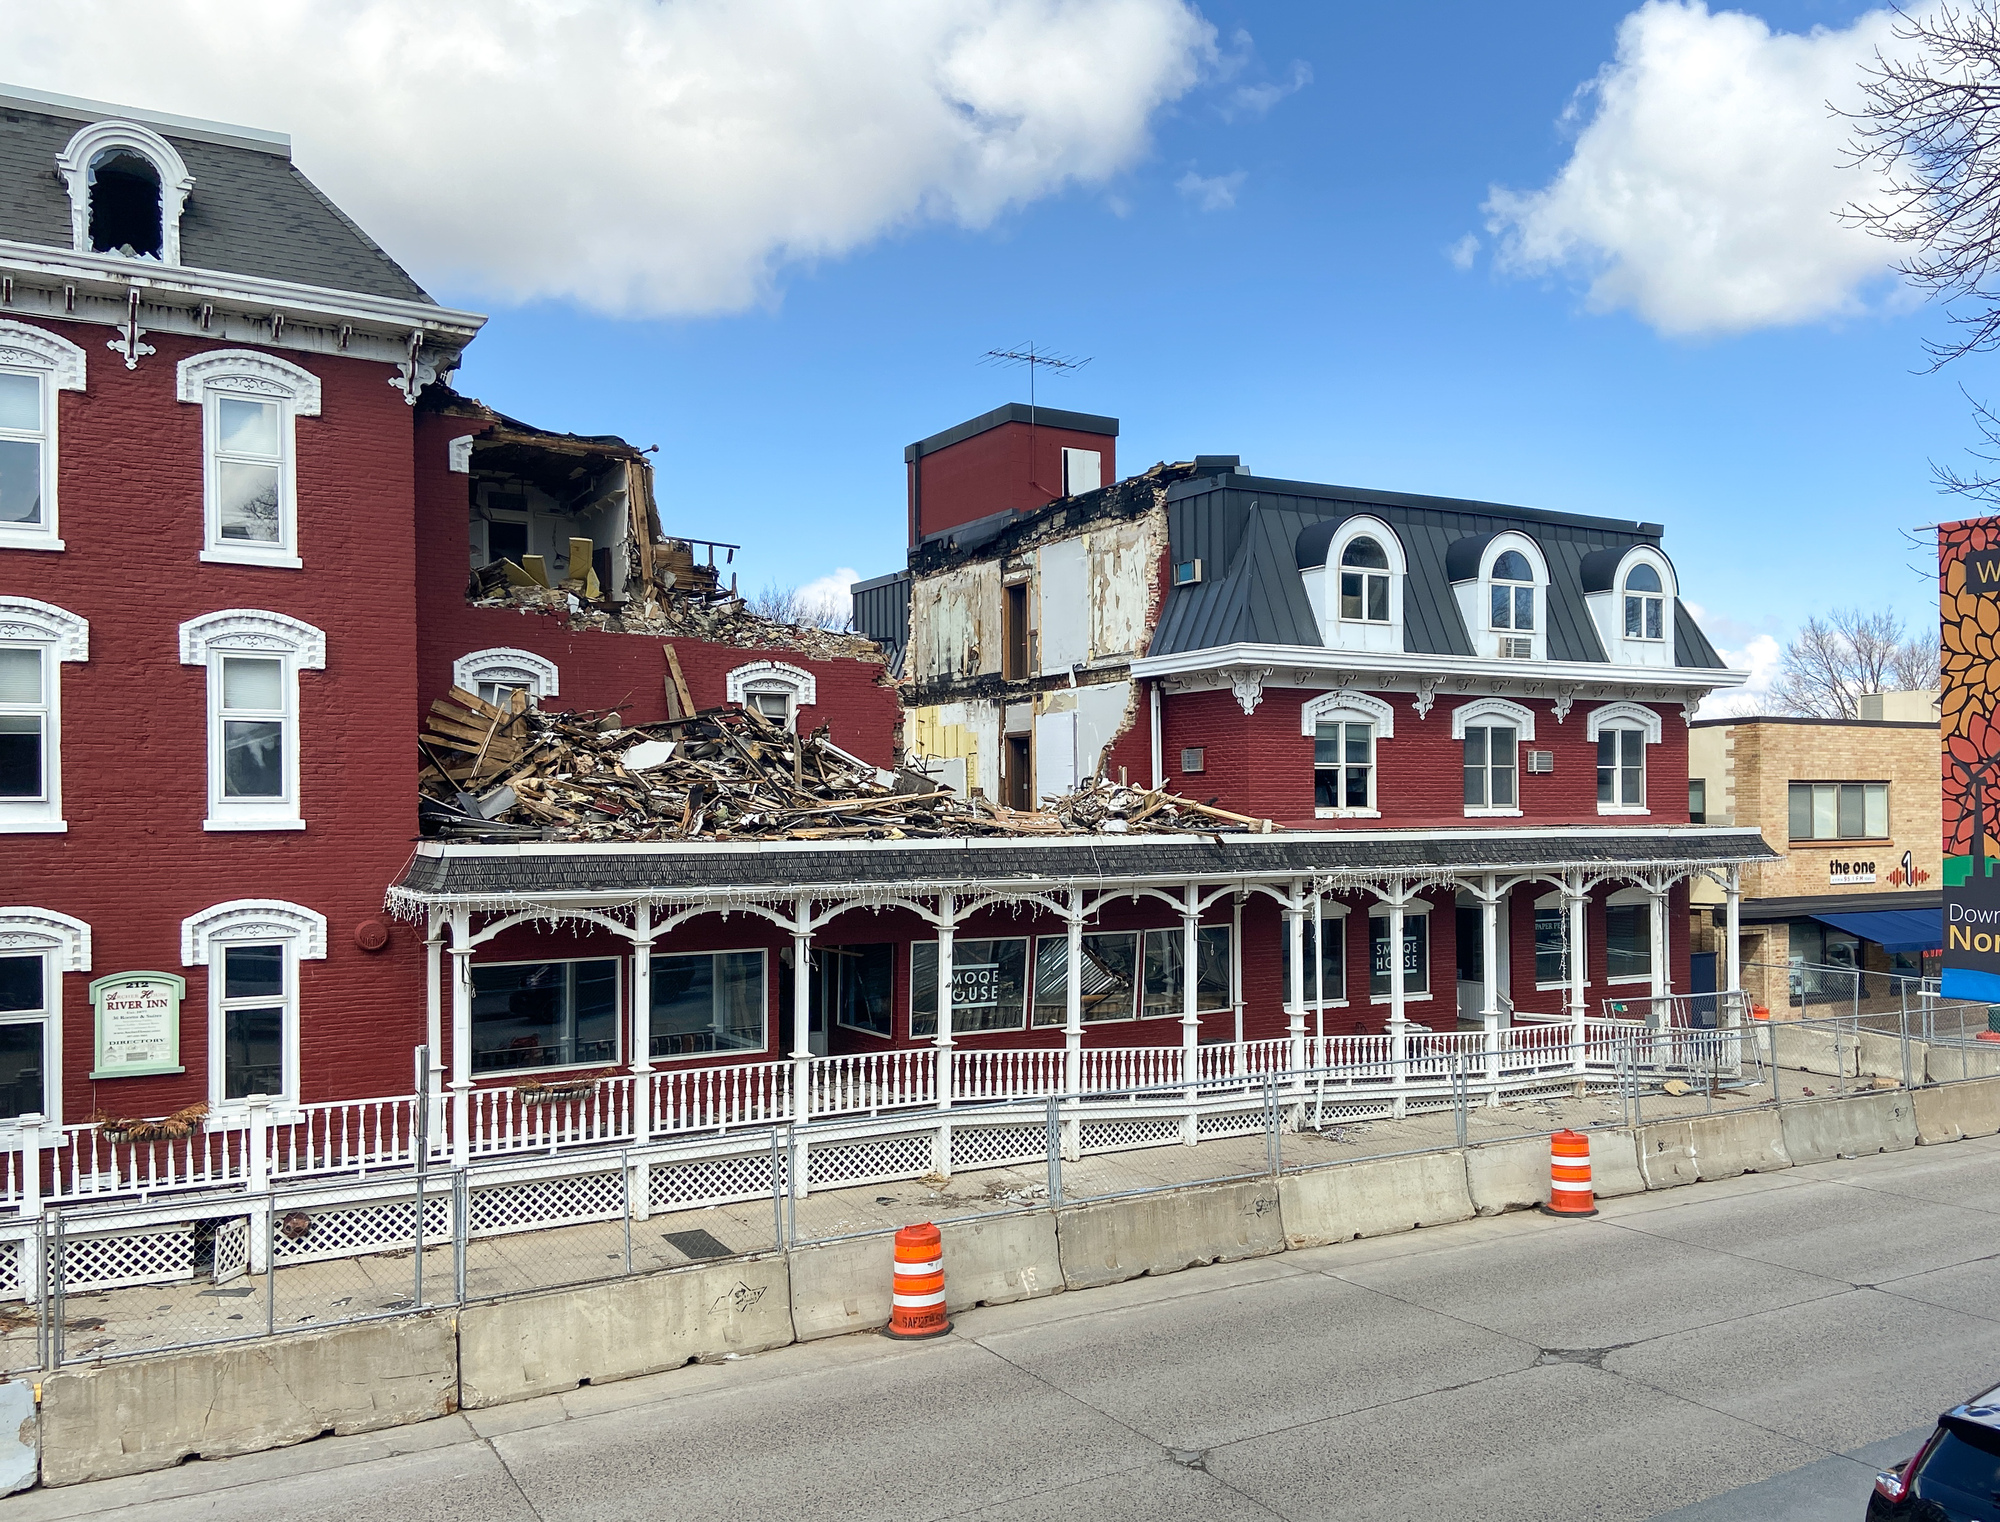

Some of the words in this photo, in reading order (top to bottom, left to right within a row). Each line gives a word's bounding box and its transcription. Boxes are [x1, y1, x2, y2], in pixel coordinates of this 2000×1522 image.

[1830, 859, 1850, 875] the
[1853, 861, 1876, 874] one
[1535, 922, 1552, 930] PAPER
[1376, 942, 1417, 955] SMQE
[1376, 955, 1417, 970] HOSE
[952, 970, 999, 984] MOQE
[952, 985, 998, 1001] OUSE
[107, 1001, 142, 1010] RIVER
[147, 999, 168, 1008] INN
